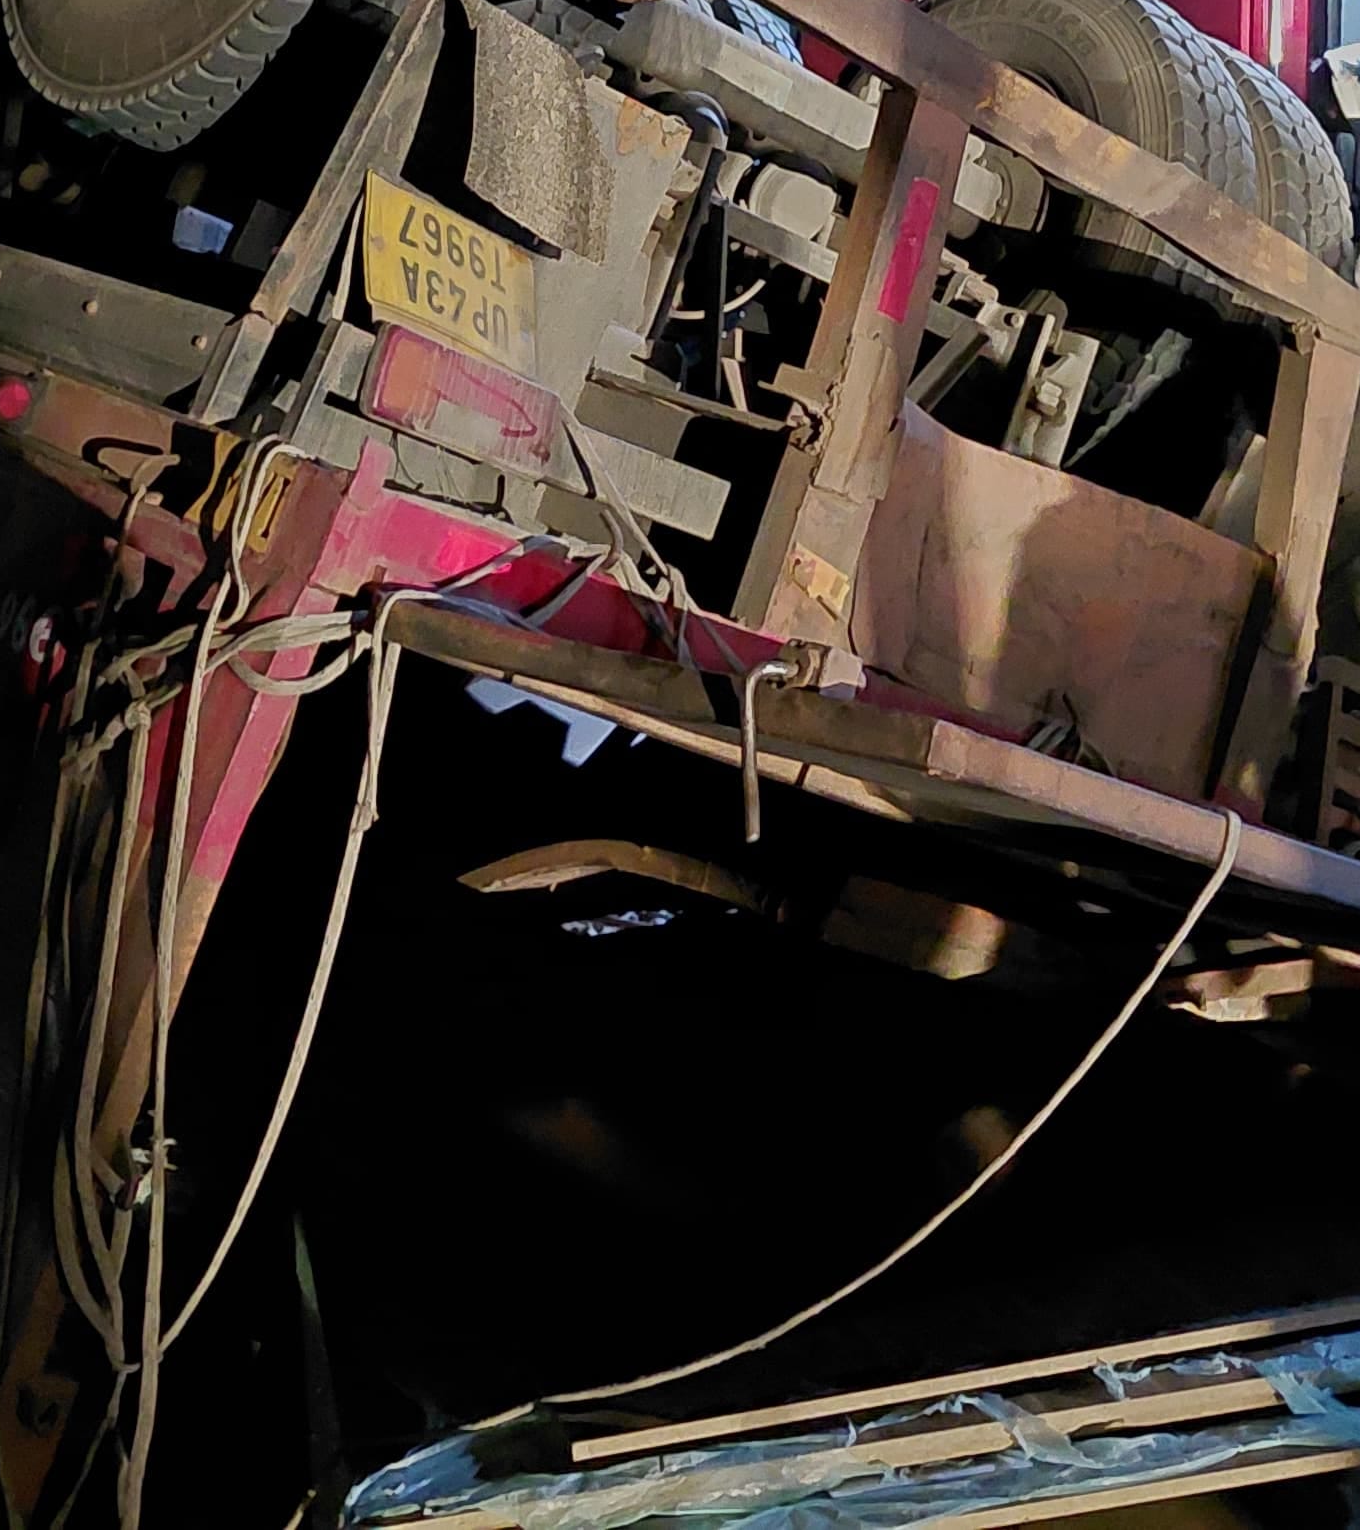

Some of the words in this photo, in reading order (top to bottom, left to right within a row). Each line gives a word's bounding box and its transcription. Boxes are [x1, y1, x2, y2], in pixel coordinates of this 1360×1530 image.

[398, 205, 507, 295] T9967
[400, 257, 467, 323] 43A
[472, 296, 510, 350] UP
